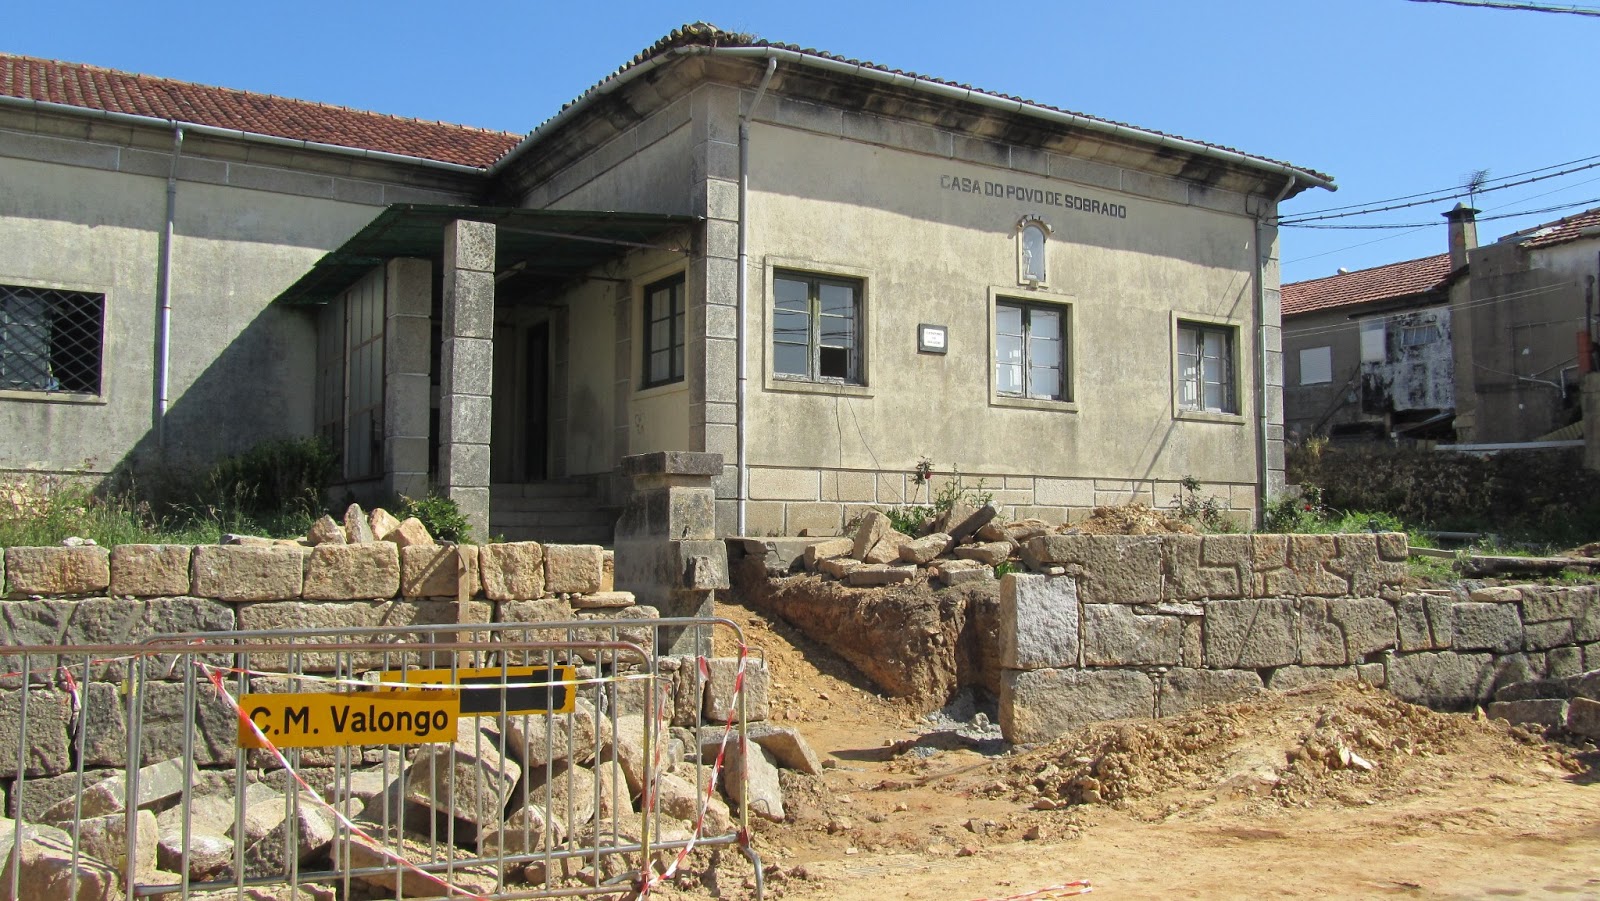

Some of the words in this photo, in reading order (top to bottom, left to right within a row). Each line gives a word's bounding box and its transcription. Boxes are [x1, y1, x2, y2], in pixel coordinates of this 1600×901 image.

[941, 174, 981, 195] CASA
[984, 181, 1003, 198] DO
[1006, 185, 1044, 204] POVO
[1045, 191, 1063, 206] DE
[1065, 195, 1127, 219] SOBRADO
[250, 706, 318, 735] C.M.
[331, 705, 449, 736] Valongo
